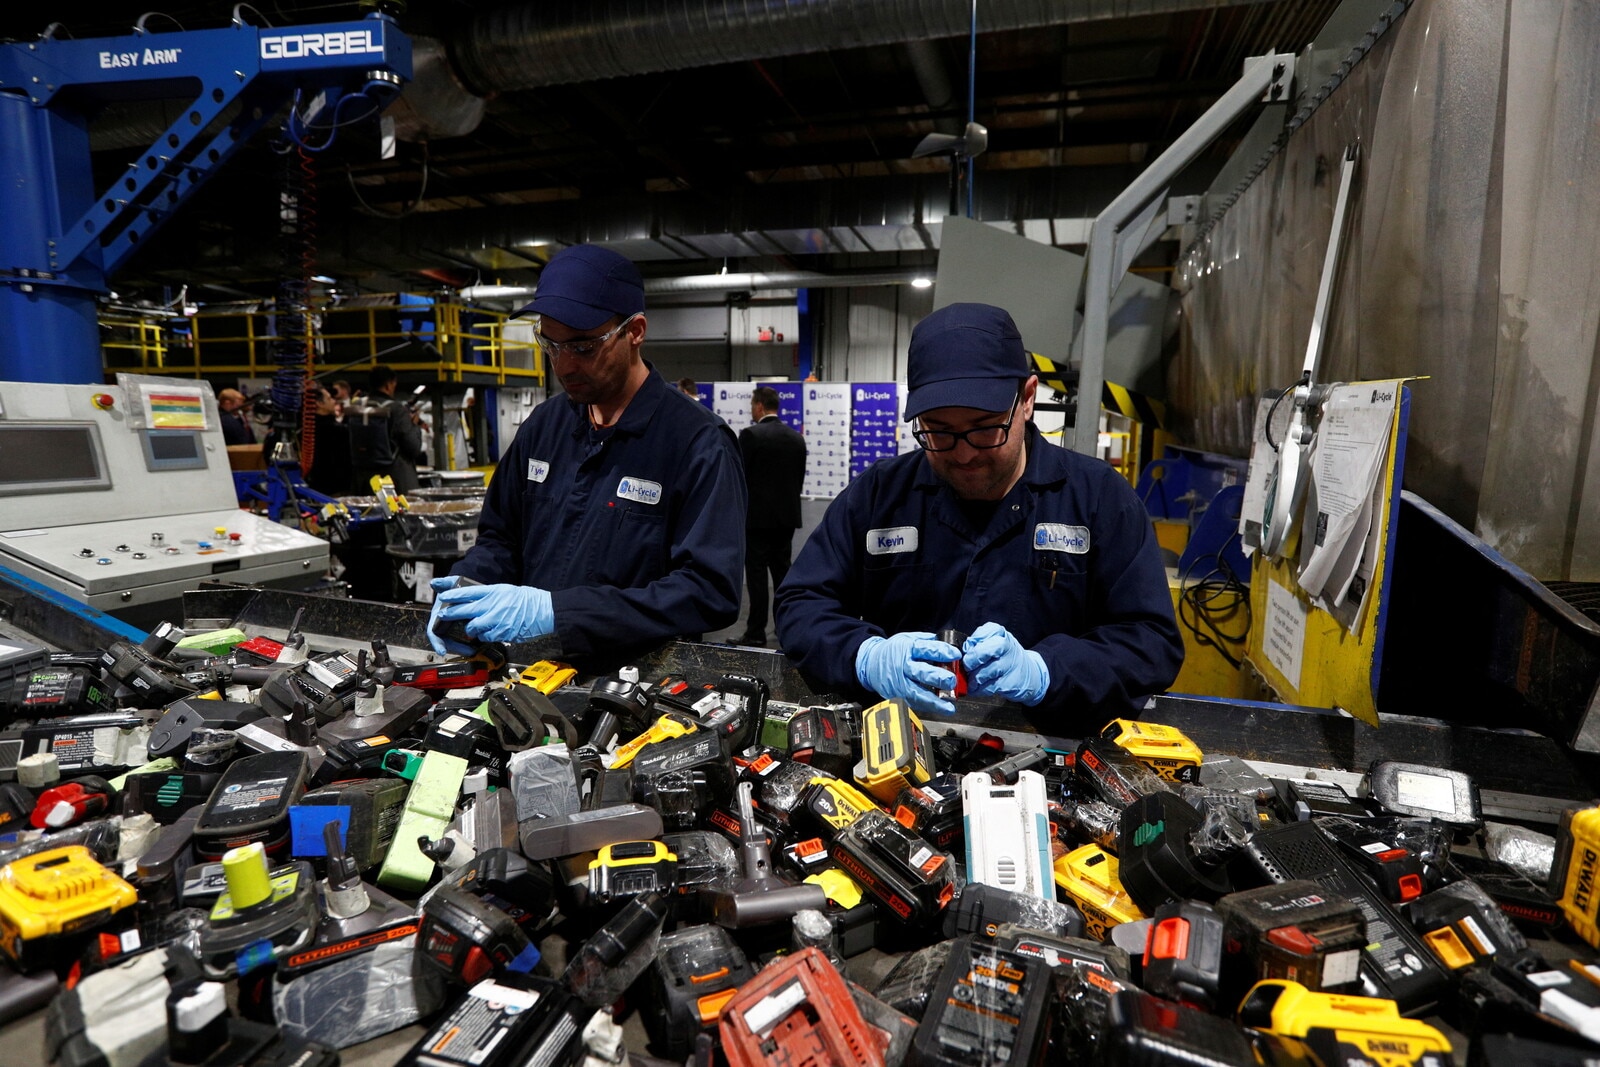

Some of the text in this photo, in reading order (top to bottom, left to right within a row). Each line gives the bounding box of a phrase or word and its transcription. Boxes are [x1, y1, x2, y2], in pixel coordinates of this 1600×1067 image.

[260, 30, 384, 59] GORBEL
[778, 391, 795, 400] Cycle
[817, 392, 842, 400] Li-Cycle
[864, 391, 890, 400] Li-Cycle
[627, 484, 658, 498] Li-Cycle
[877, 536, 904, 548] Kevin
[837, 799, 859, 818] DeWAL
[836, 850, 875, 886] LITHIUM
[295, 941, 360, 964] LITHIUM
[1366, 1039, 1410, 1055] DeWALT
